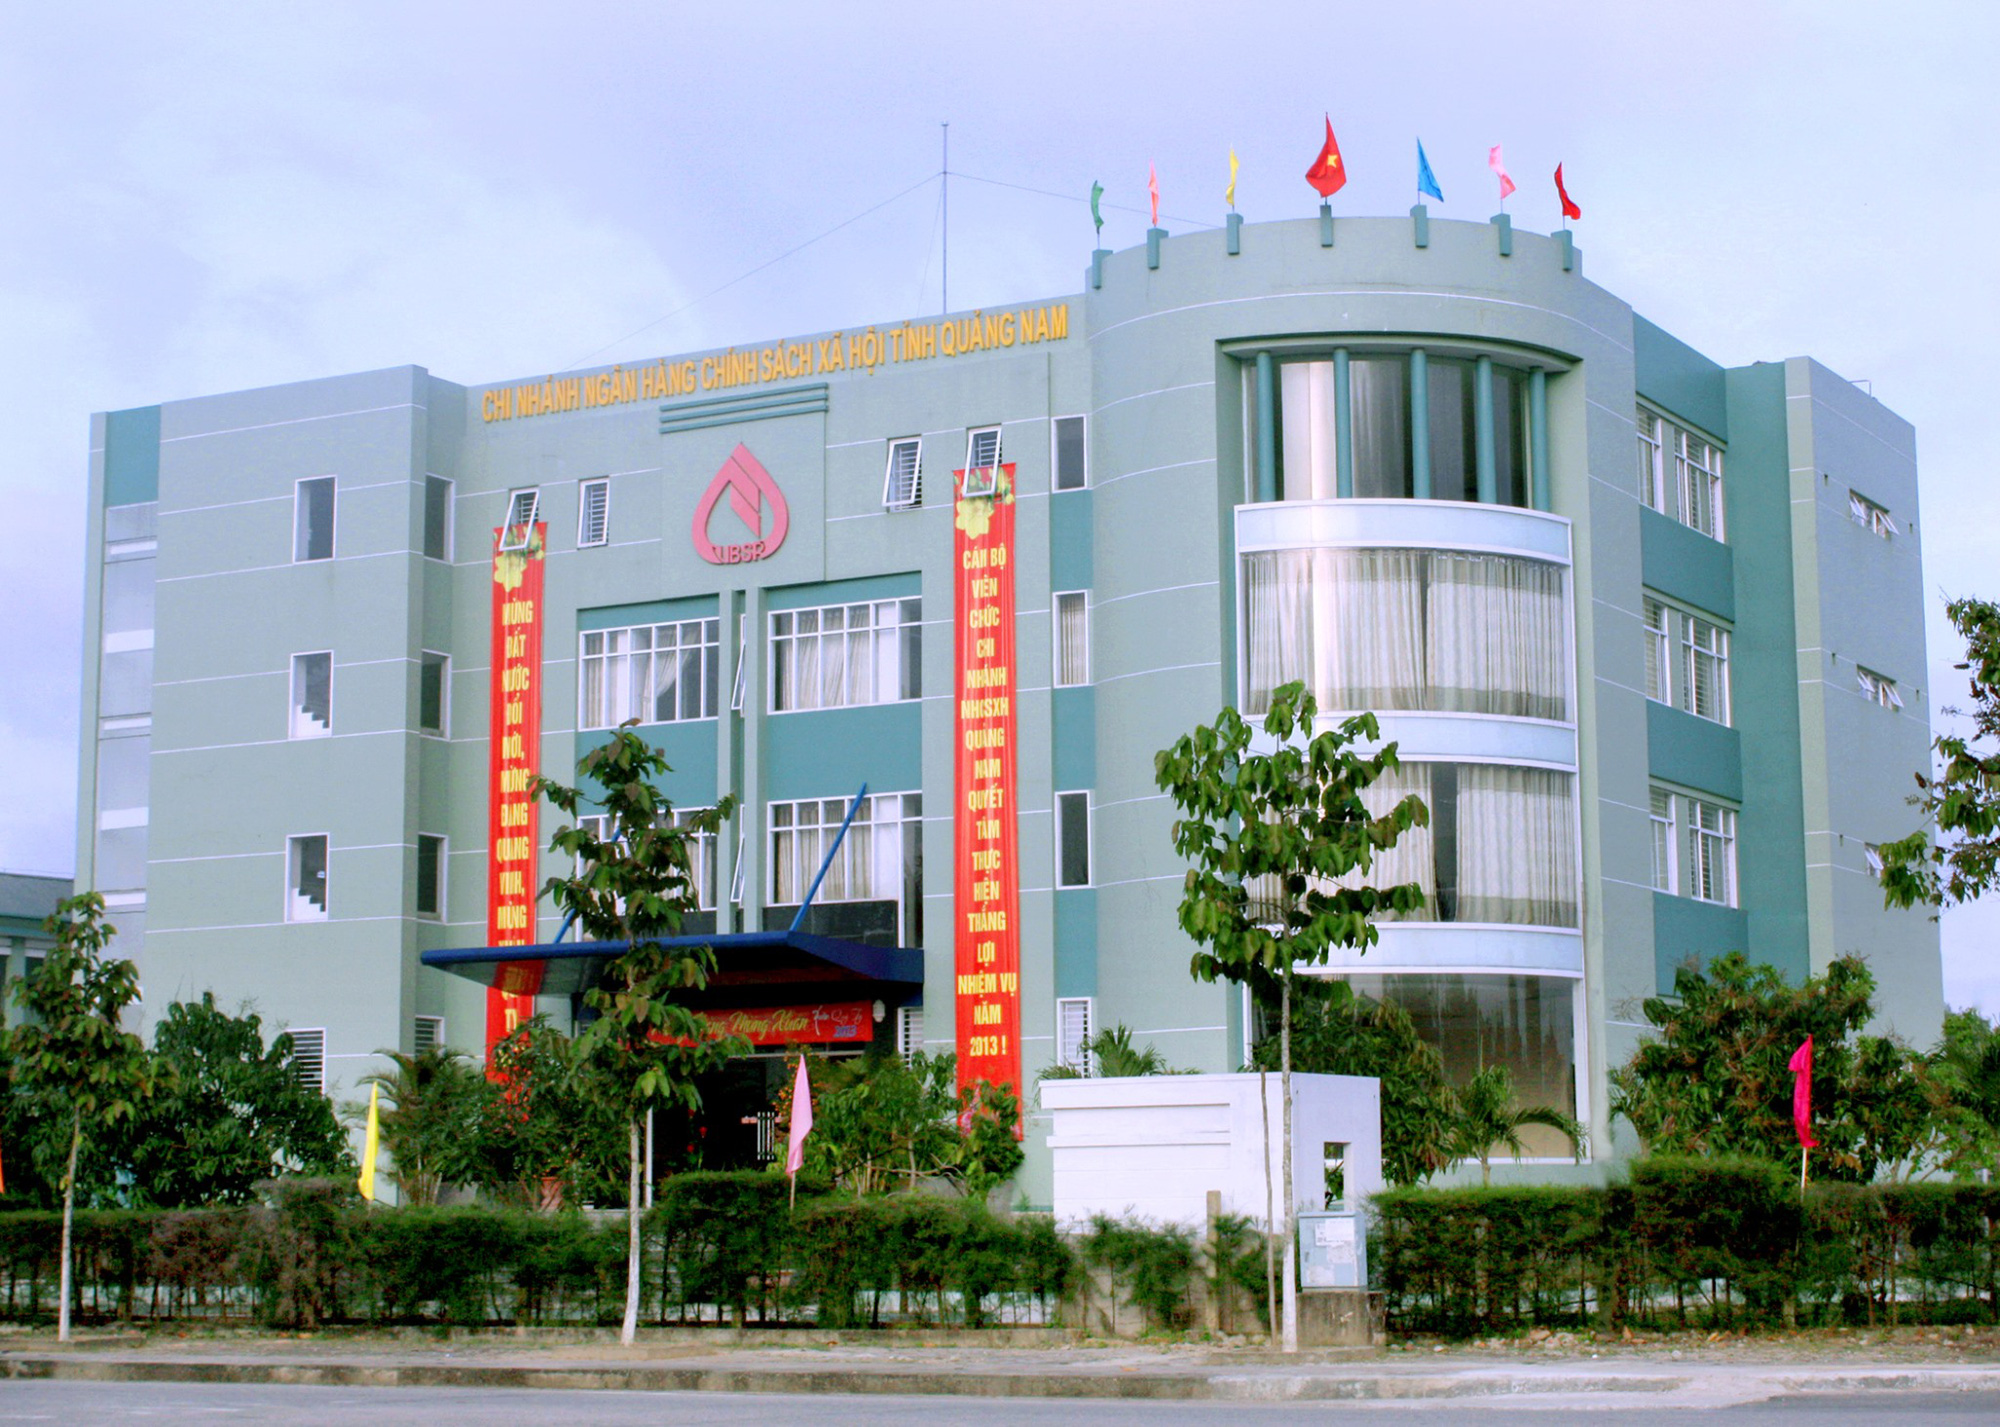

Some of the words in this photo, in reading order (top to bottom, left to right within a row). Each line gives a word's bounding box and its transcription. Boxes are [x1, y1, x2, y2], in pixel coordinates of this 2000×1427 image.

[482, 388, 512, 423] CHI
[517, 374, 580, 418] NHÁNH
[585, 365, 637, 409] NGÂN
[642, 358, 696, 400] HÀNG
[702, 347, 758, 390] CHÍNH
[761, 339, 813, 383] SÁCH
[817, 332, 846, 374] XÃ
[850, 326, 885, 376] HỘI
[890, 320, 937, 363] TỈNH
[941, 309, 1015, 357] QUẢNG
[1020, 304, 1068, 345] NAM
[990, 542, 1007, 570] BỘ
[976, 637, 995, 659] CHI
[967, 664, 1007, 689] NHÁNH
[975, 758, 1001, 780] NAM
[977, 940, 995, 967] LỢI
[958, 970, 997, 998] NHIỆM
[1000, 973, 1017, 997] VỤ
[974, 1001, 1002, 1025] NĂM
[970, 1036, 998, 1056] 2013
